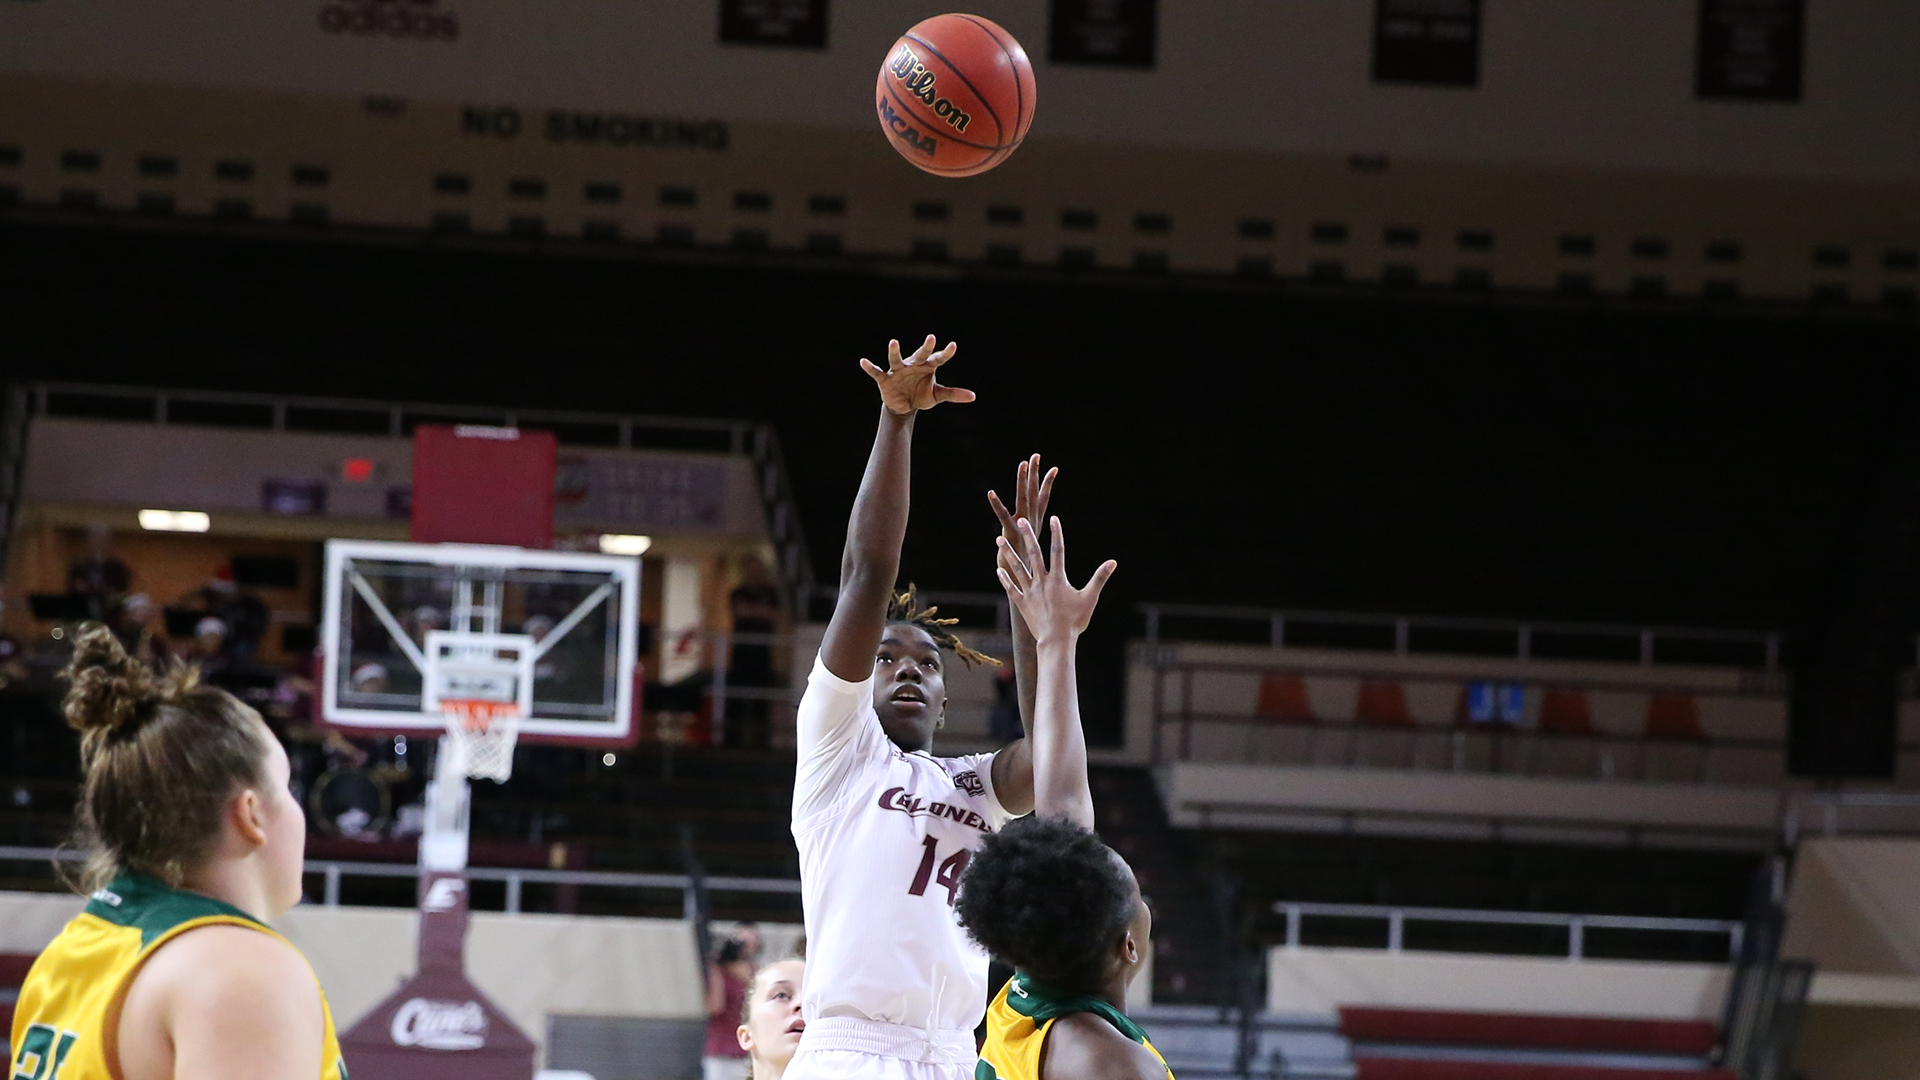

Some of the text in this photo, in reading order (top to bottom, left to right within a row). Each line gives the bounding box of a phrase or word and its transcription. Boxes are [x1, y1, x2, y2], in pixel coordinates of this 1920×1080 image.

[318, 3, 461, 41] adidas
[890, 43, 971, 133] Wilson
[462, 106, 729, 149] NO SMOKING
[879, 96, 937, 156] NCAA
[908, 833, 971, 907] 14
